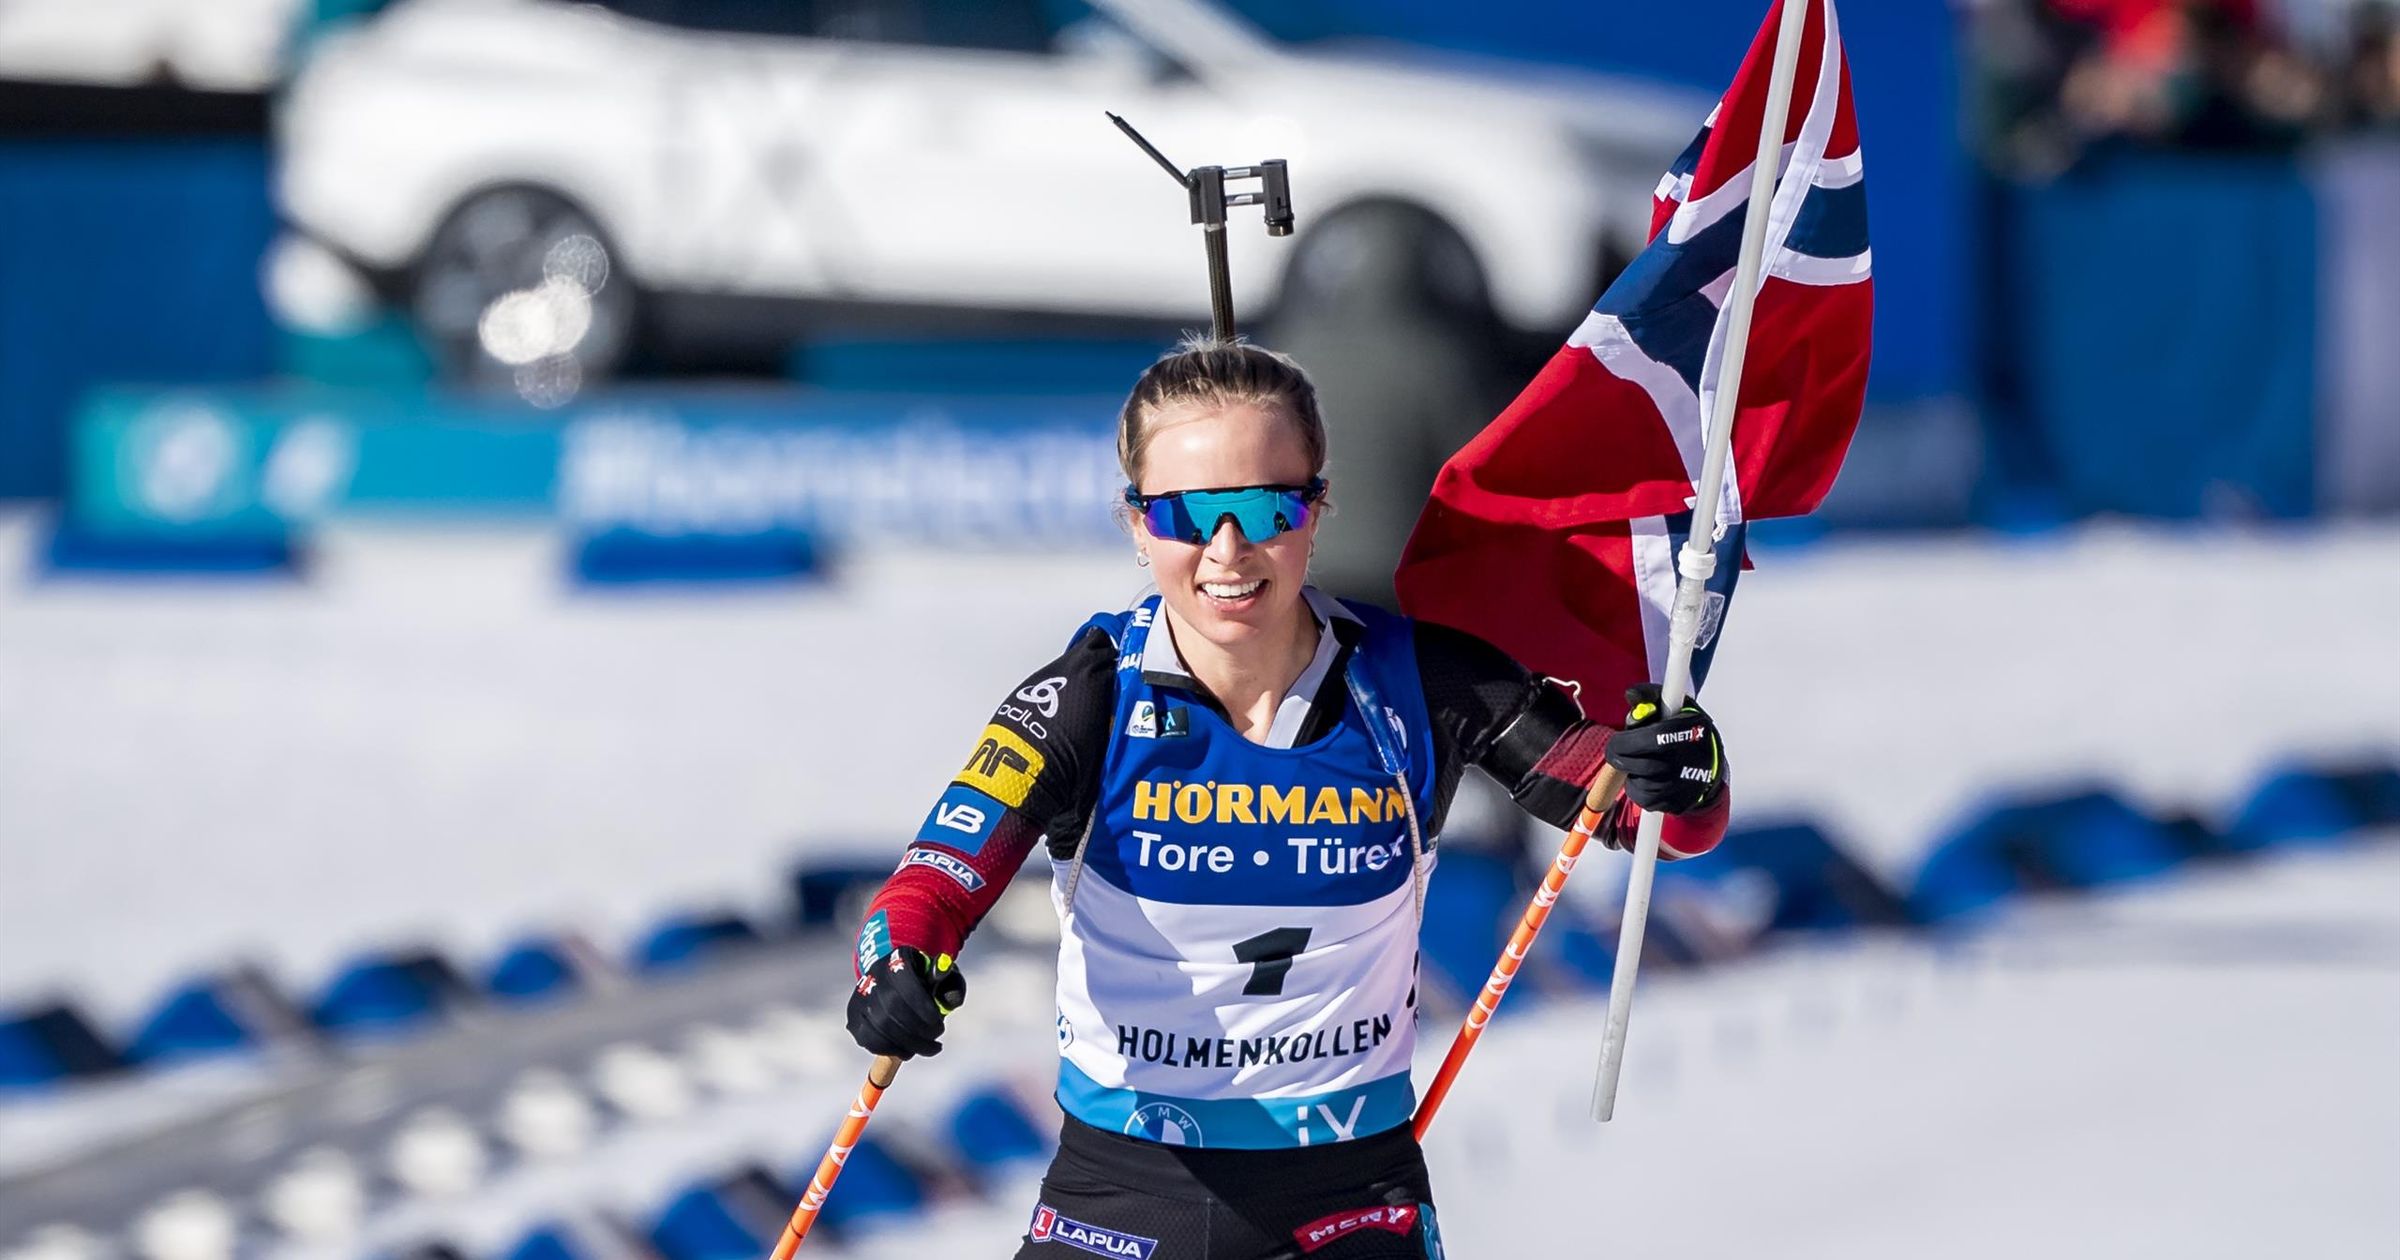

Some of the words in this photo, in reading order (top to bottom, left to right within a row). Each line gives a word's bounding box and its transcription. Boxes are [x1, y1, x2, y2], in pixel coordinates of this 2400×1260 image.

[998, 704, 1047, 739] odlo
[936, 802, 986, 834] VB
[1132, 780, 1405, 824] HÖRMANN
[911, 852, 974, 887] LAPUA
[1132, 830, 1235, 873] Tore
[1231, 927, 1313, 996] 1
[1117, 1012, 1392, 1068] HOLMENKOLLEN
[1135, 1106, 1193, 1131] BMW
[1055, 1220, 1142, 1259] LAPUA
